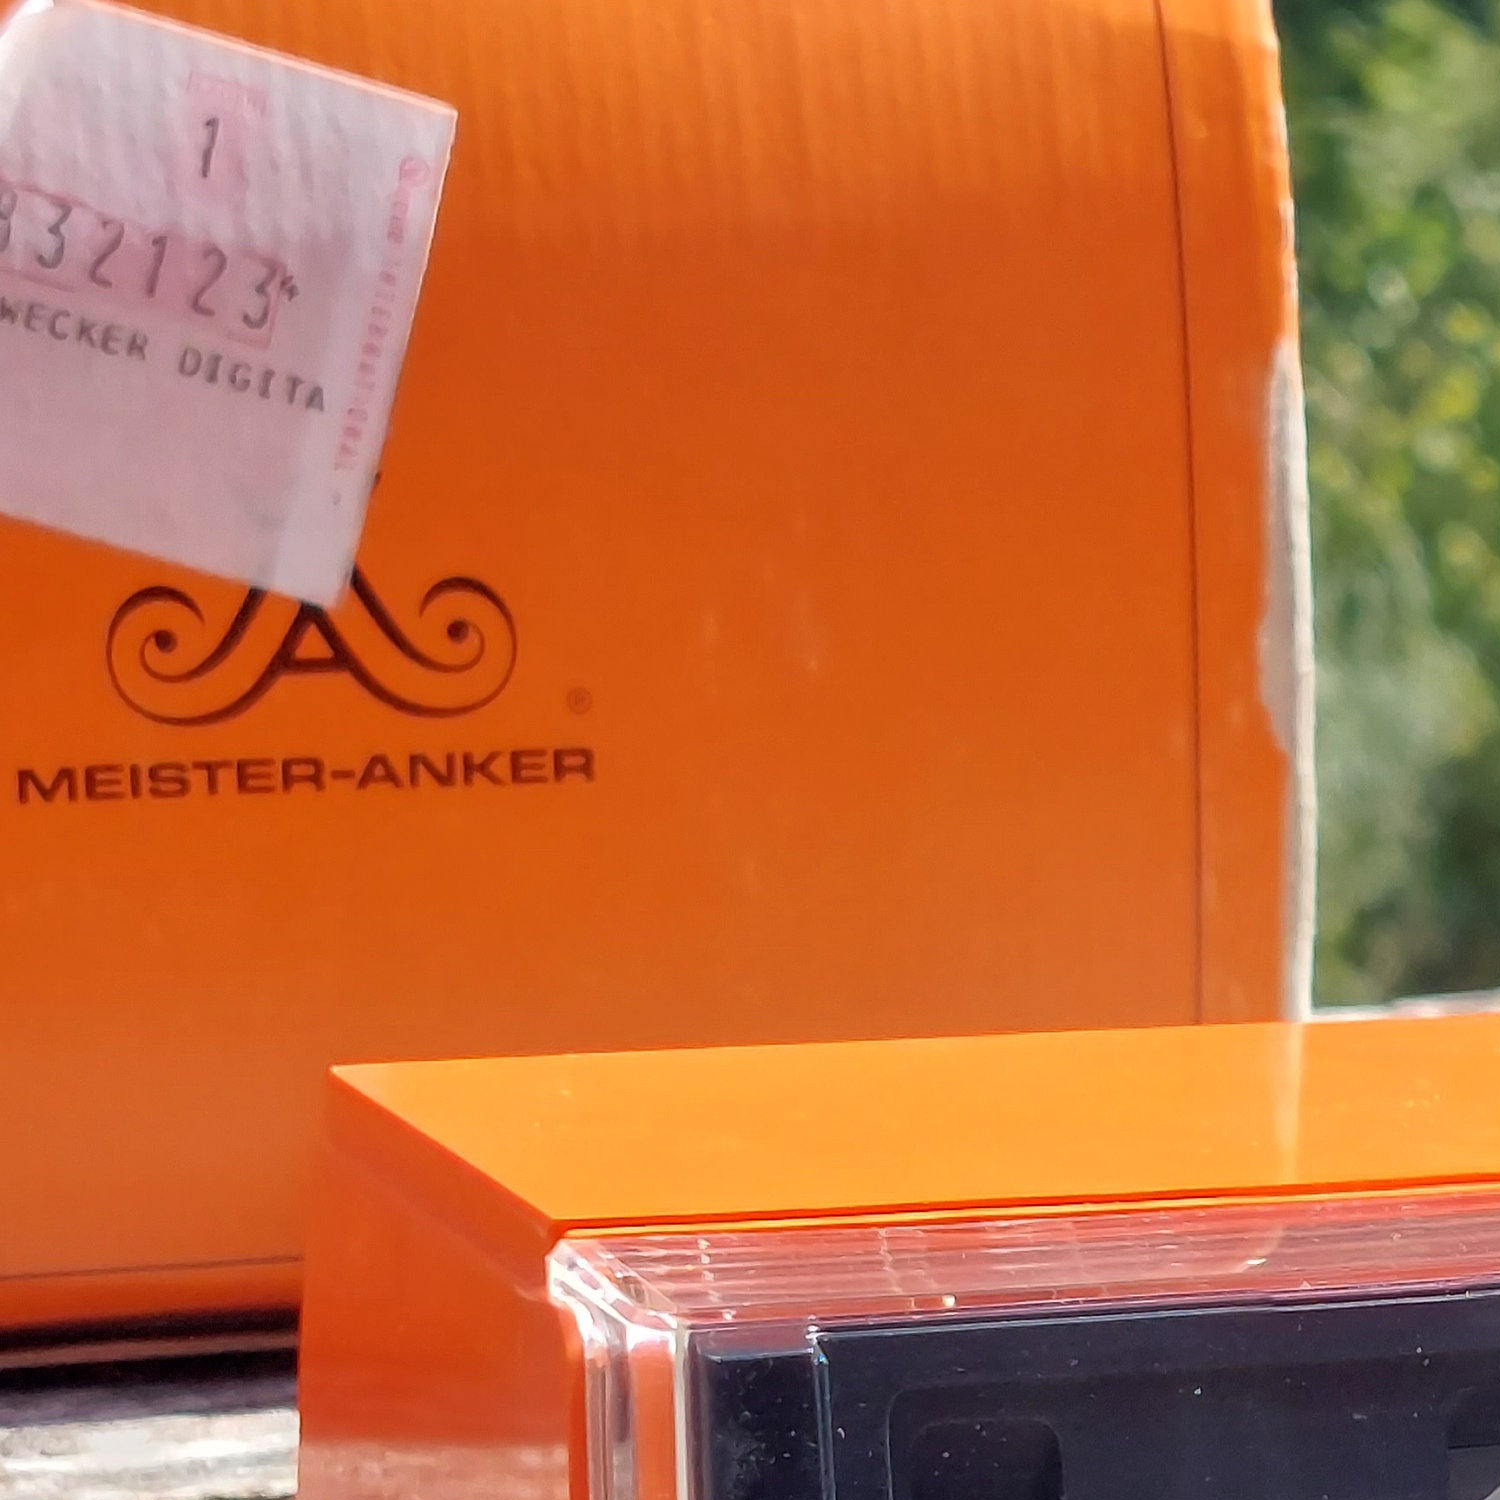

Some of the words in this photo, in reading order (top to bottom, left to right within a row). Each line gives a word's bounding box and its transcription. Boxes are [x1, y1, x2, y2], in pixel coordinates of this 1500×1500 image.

[202, 117, 220, 178] 1
[0, 297, 148, 361] WECKER
[178, 346, 325, 412] DIGITA
[17, 748, 596, 805] MEISTER-ANKER
